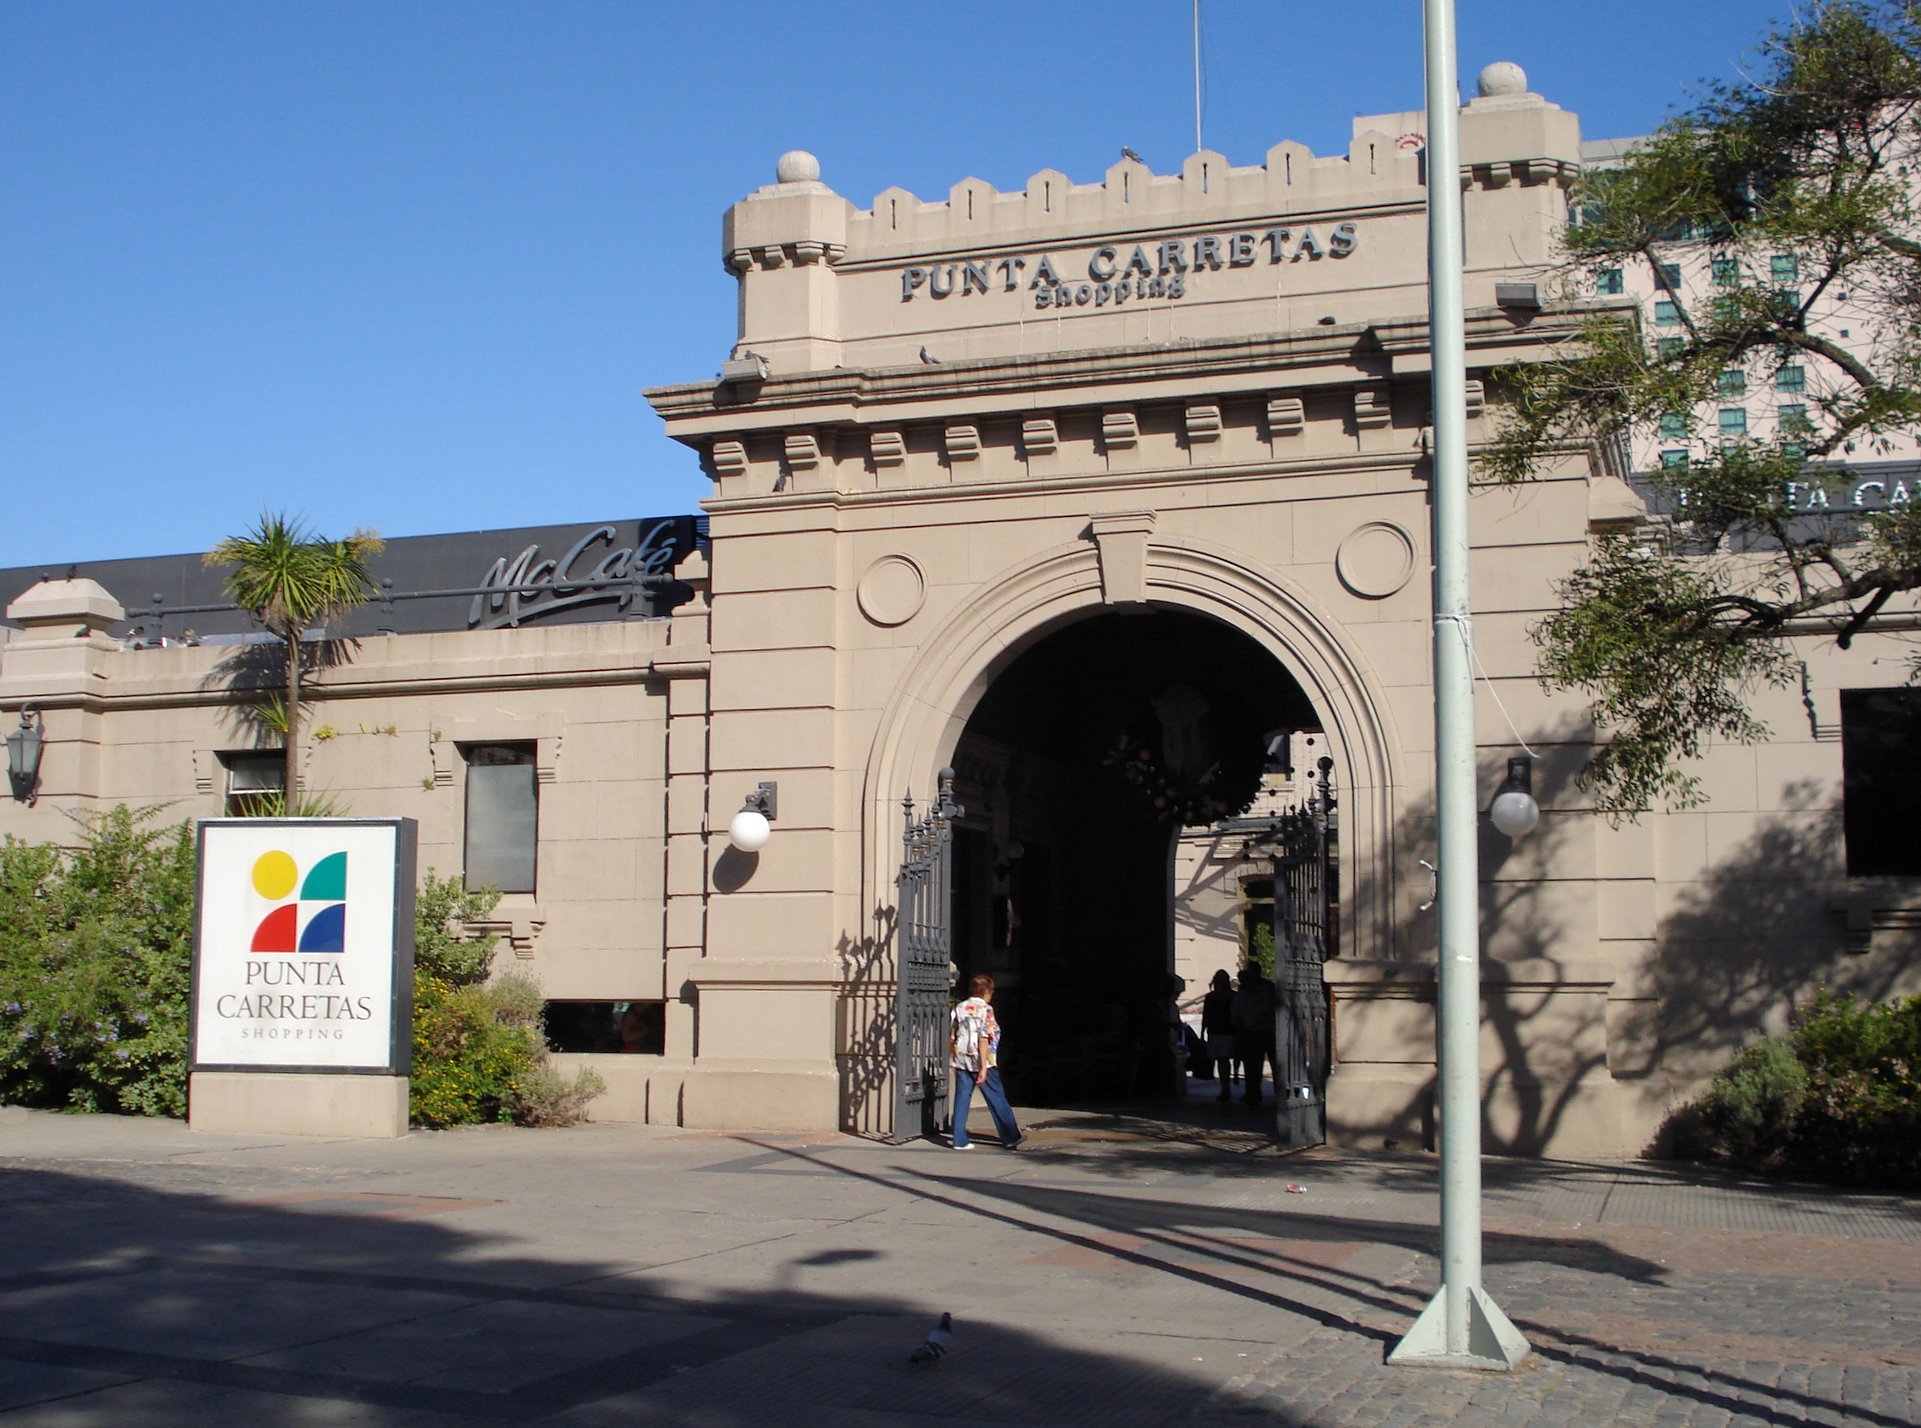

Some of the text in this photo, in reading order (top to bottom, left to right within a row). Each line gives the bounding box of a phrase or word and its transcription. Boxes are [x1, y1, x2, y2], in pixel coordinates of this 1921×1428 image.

[901, 221, 1358, 302] PUNTA CARRETAS
[468, 519, 676, 627] McCafé
[245, 961, 346, 986] PUNTA
[216, 994, 373, 1020] CARRETAS
[241, 1028, 344, 1040] SHOPPING
